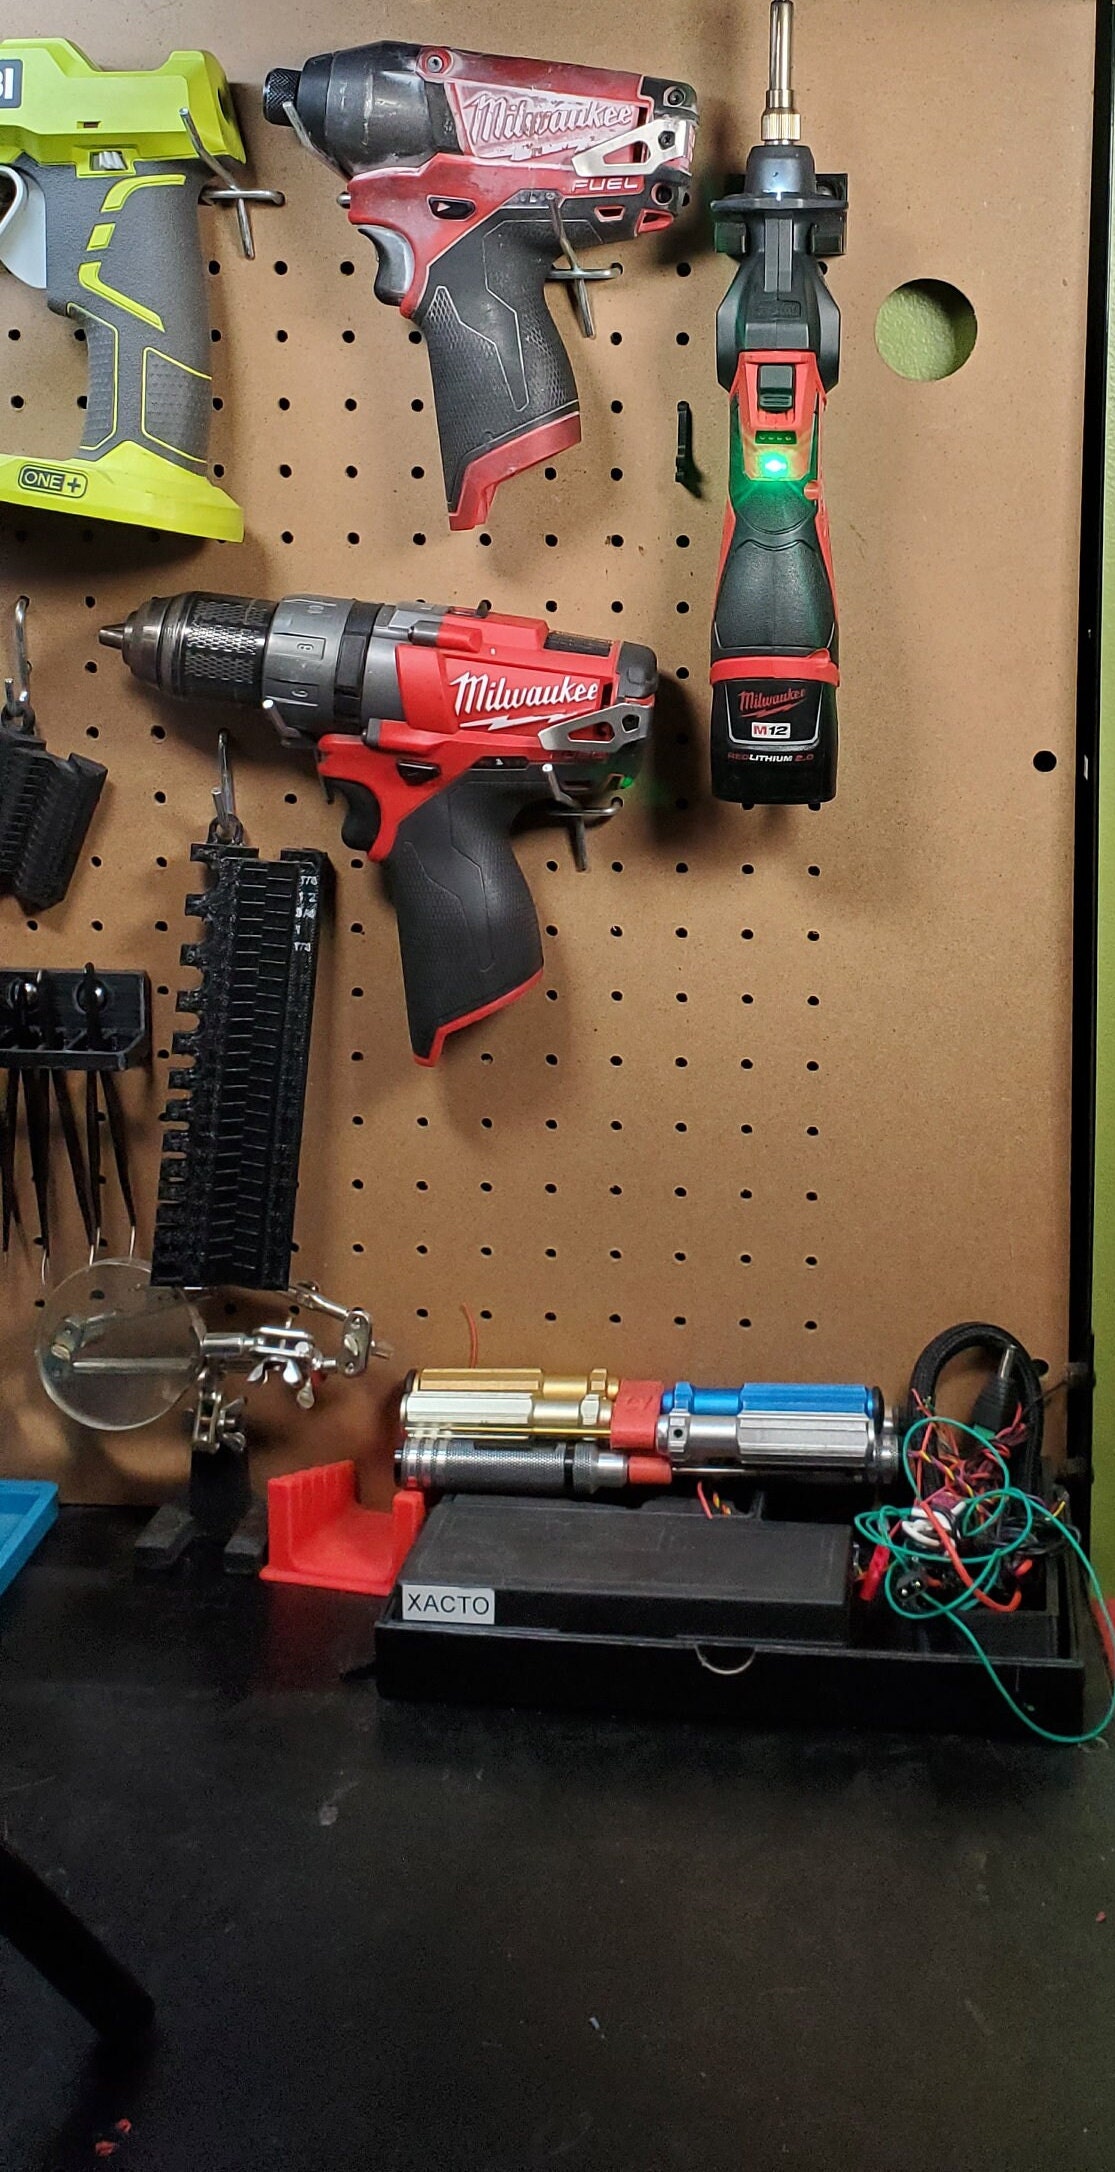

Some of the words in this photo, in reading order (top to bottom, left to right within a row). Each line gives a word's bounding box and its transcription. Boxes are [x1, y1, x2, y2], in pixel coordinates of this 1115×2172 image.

[462, 91, 633, 144] Milwaukee
[571, 177, 639, 192] FUEL
[450, 671, 599, 717] Milwaukee
[738, 687, 807, 712] Milwaukee
[753, 725, 788, 736] M12
[727, 752, 793, 762] REDLITHIUM
[794, 753, 814, 762] 2.0
[407, 1593, 489, 1615] XACTO
